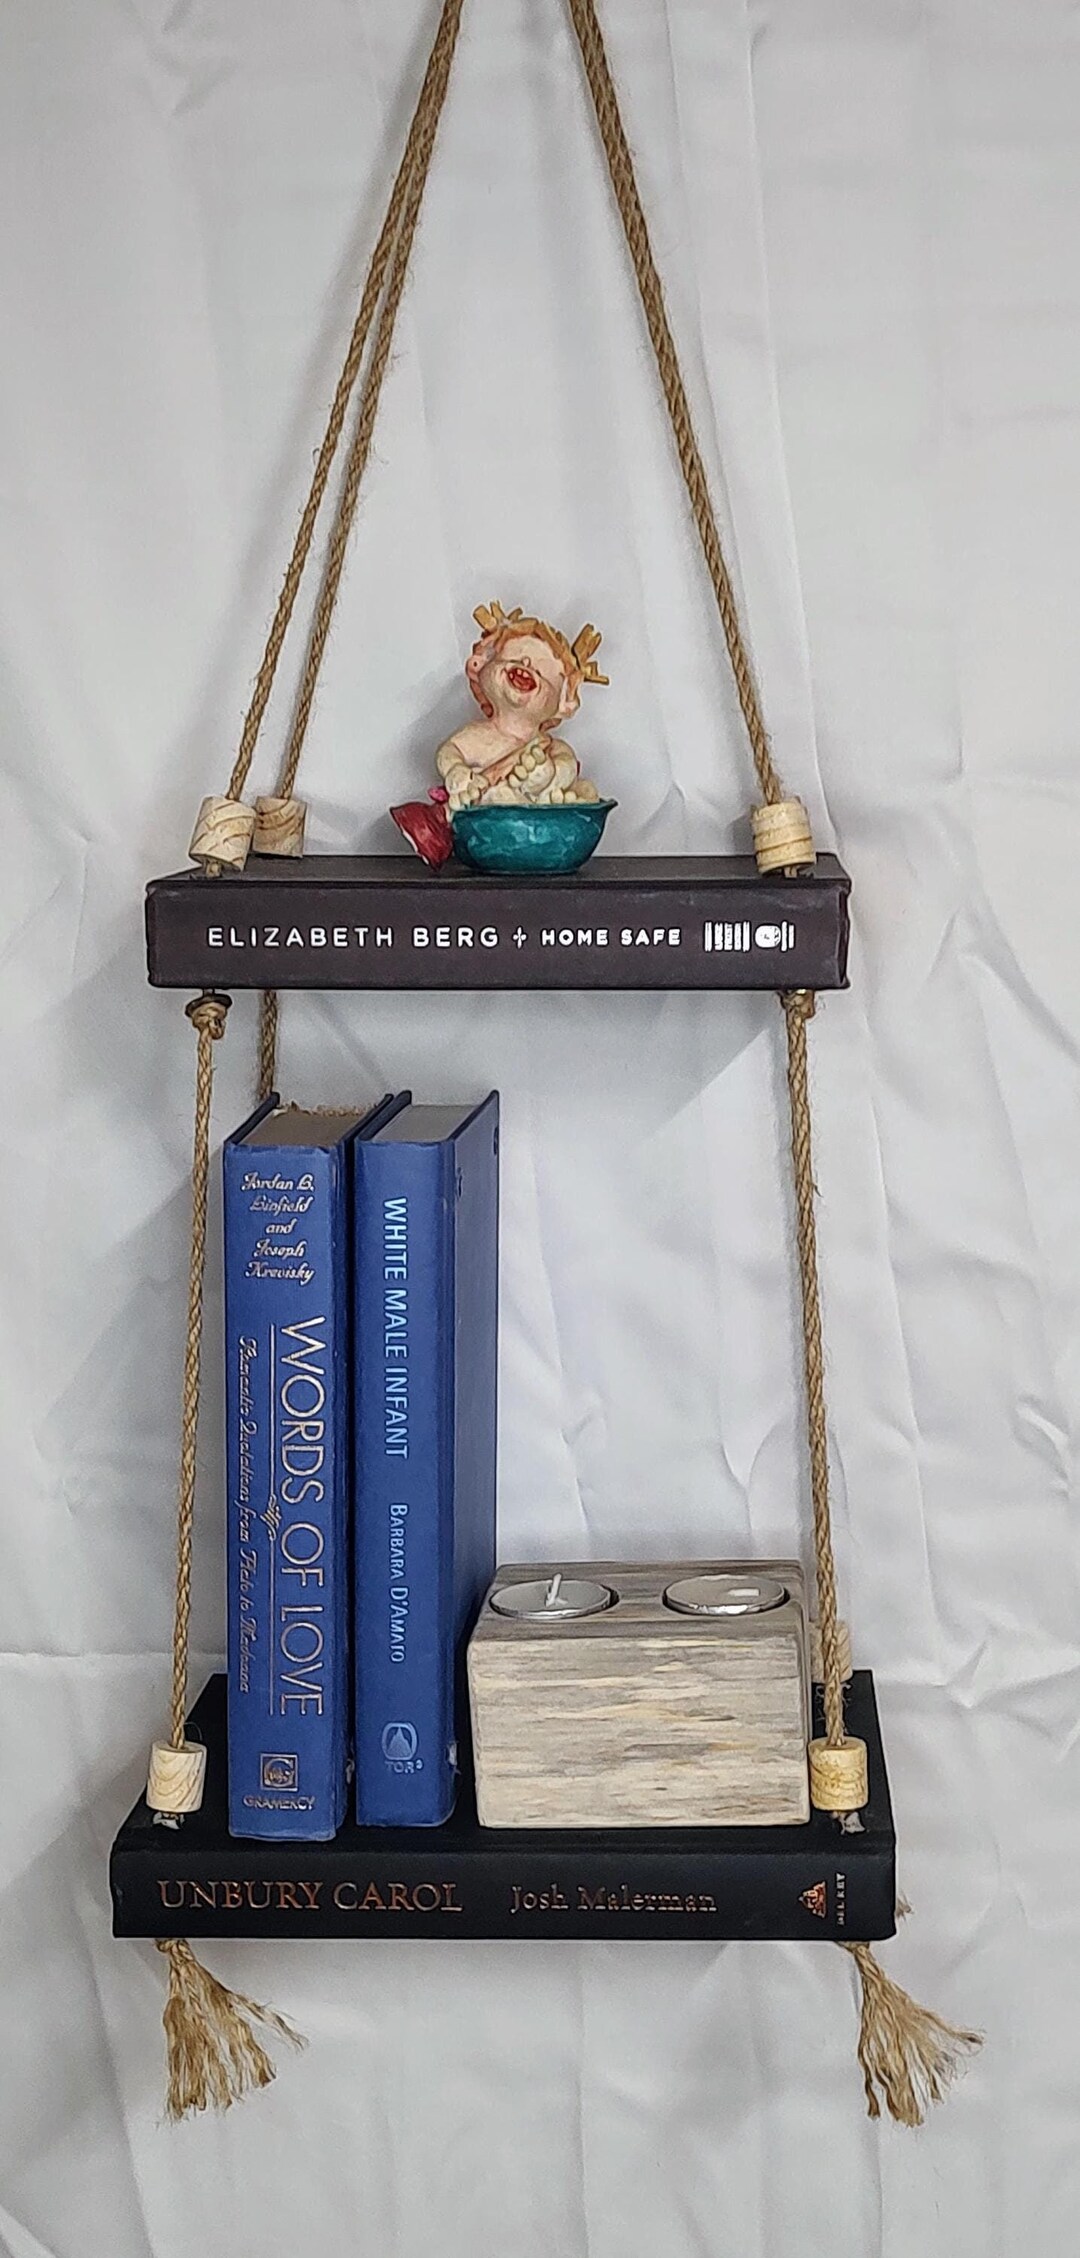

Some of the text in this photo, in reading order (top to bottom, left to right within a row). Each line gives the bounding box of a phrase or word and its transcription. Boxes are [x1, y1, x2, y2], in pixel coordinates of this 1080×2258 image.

[207, 926, 499, 948] ELIZABETH BERG
[541, 927, 682, 946] HOME SAFE
[241, 1171, 293, 1191] Jordan
[249, 1195, 314, 1216] Linfield
[265, 1218, 297, 1234] and
[253, 1238, 307, 1260] Joseph
[384, 1198, 408, 1459] WHITE MALE INFANT
[234, 1499, 257, 1542] from
[280, 1316, 326, 1715] WORDS OF LOVE
[390, 1504, 408, 1580] BARBARA
[239, 1547, 257, 1592] Plato
[239, 1595, 254, 1611] to
[239, 1615, 257, 1693] Madonna
[157, 1879, 463, 1912] UNBURY CAROL
[510, 1884, 717, 1914] Josh Malerman
